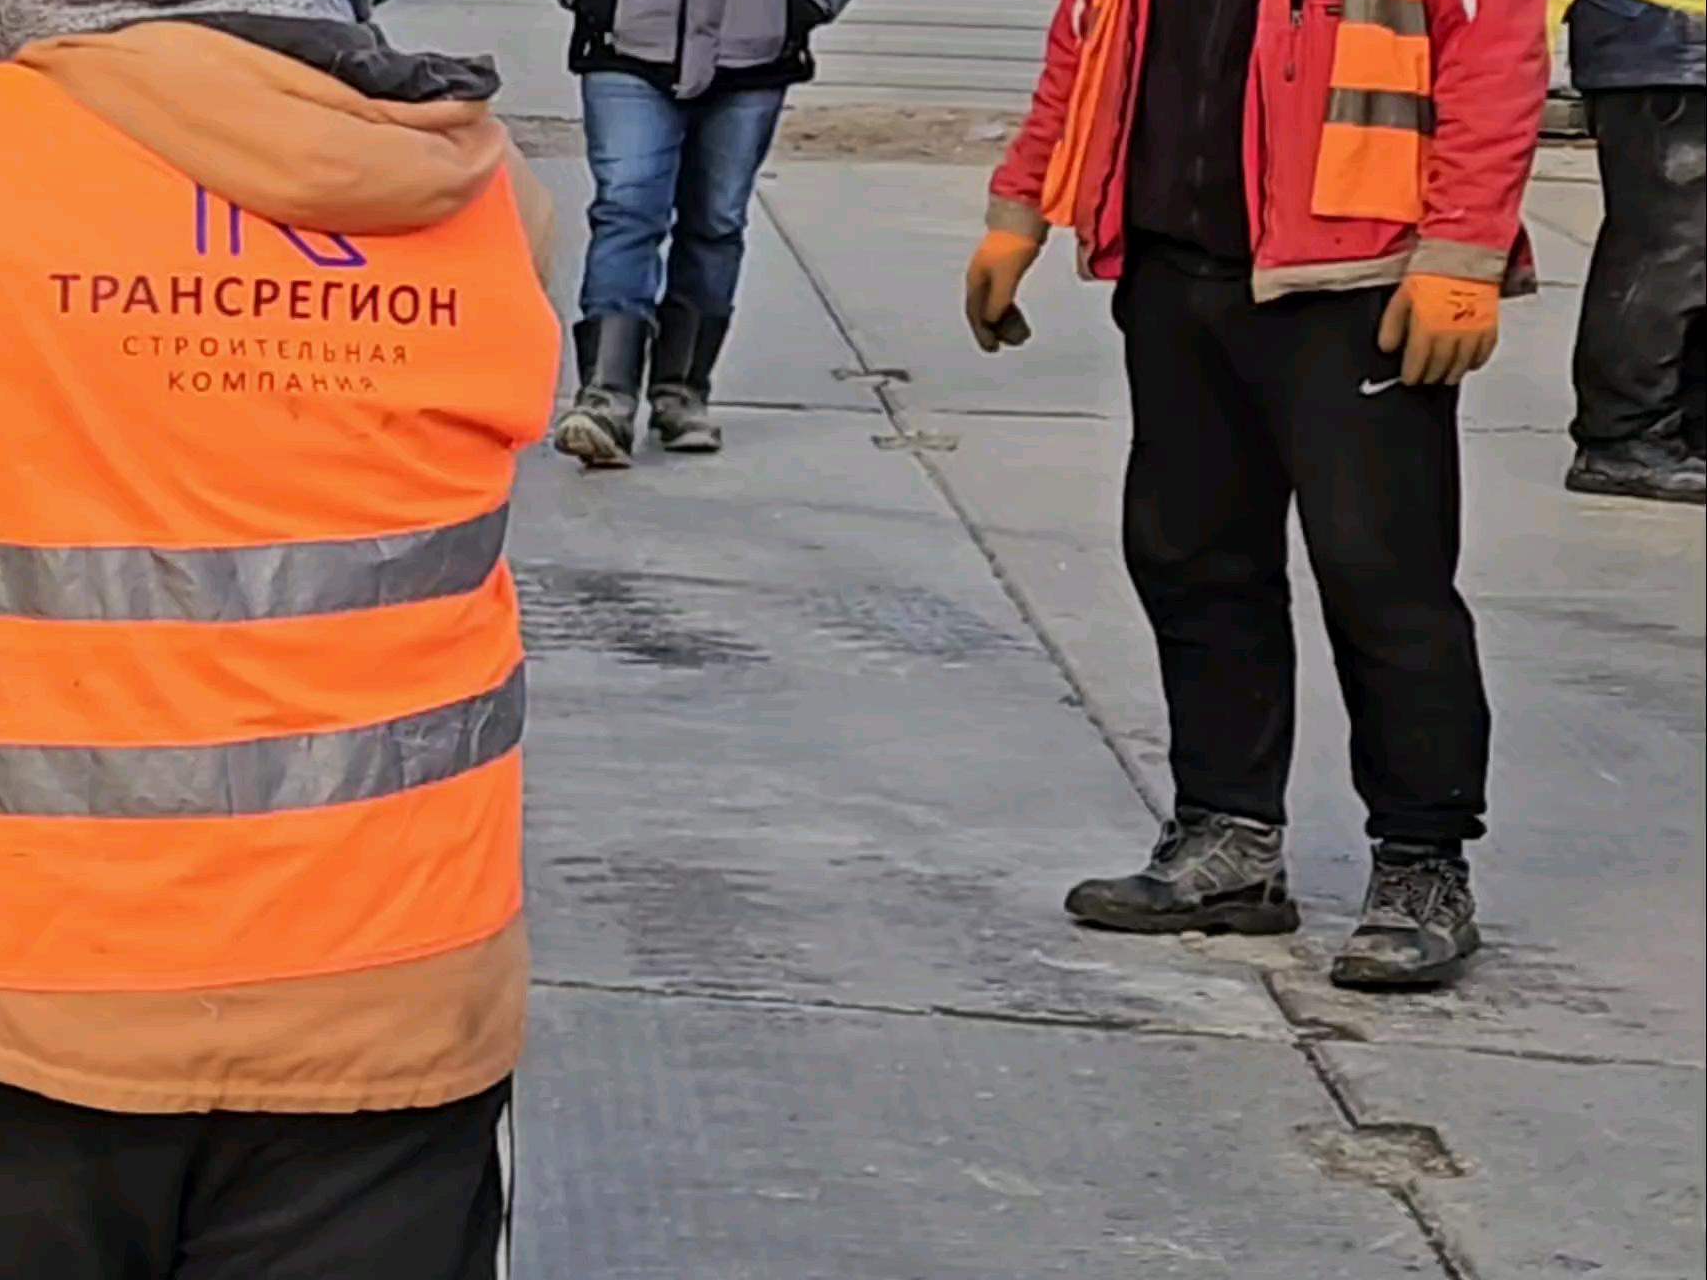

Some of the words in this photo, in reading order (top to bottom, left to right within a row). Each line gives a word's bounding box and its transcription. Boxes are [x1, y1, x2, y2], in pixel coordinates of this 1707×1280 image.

[48, 273, 458, 327] ТРАНСРЕГИОН
[121, 334, 408, 366] СТРОИТЕЛЬНАЯ
[168, 370, 379, 394] КОМПАНИЯ
